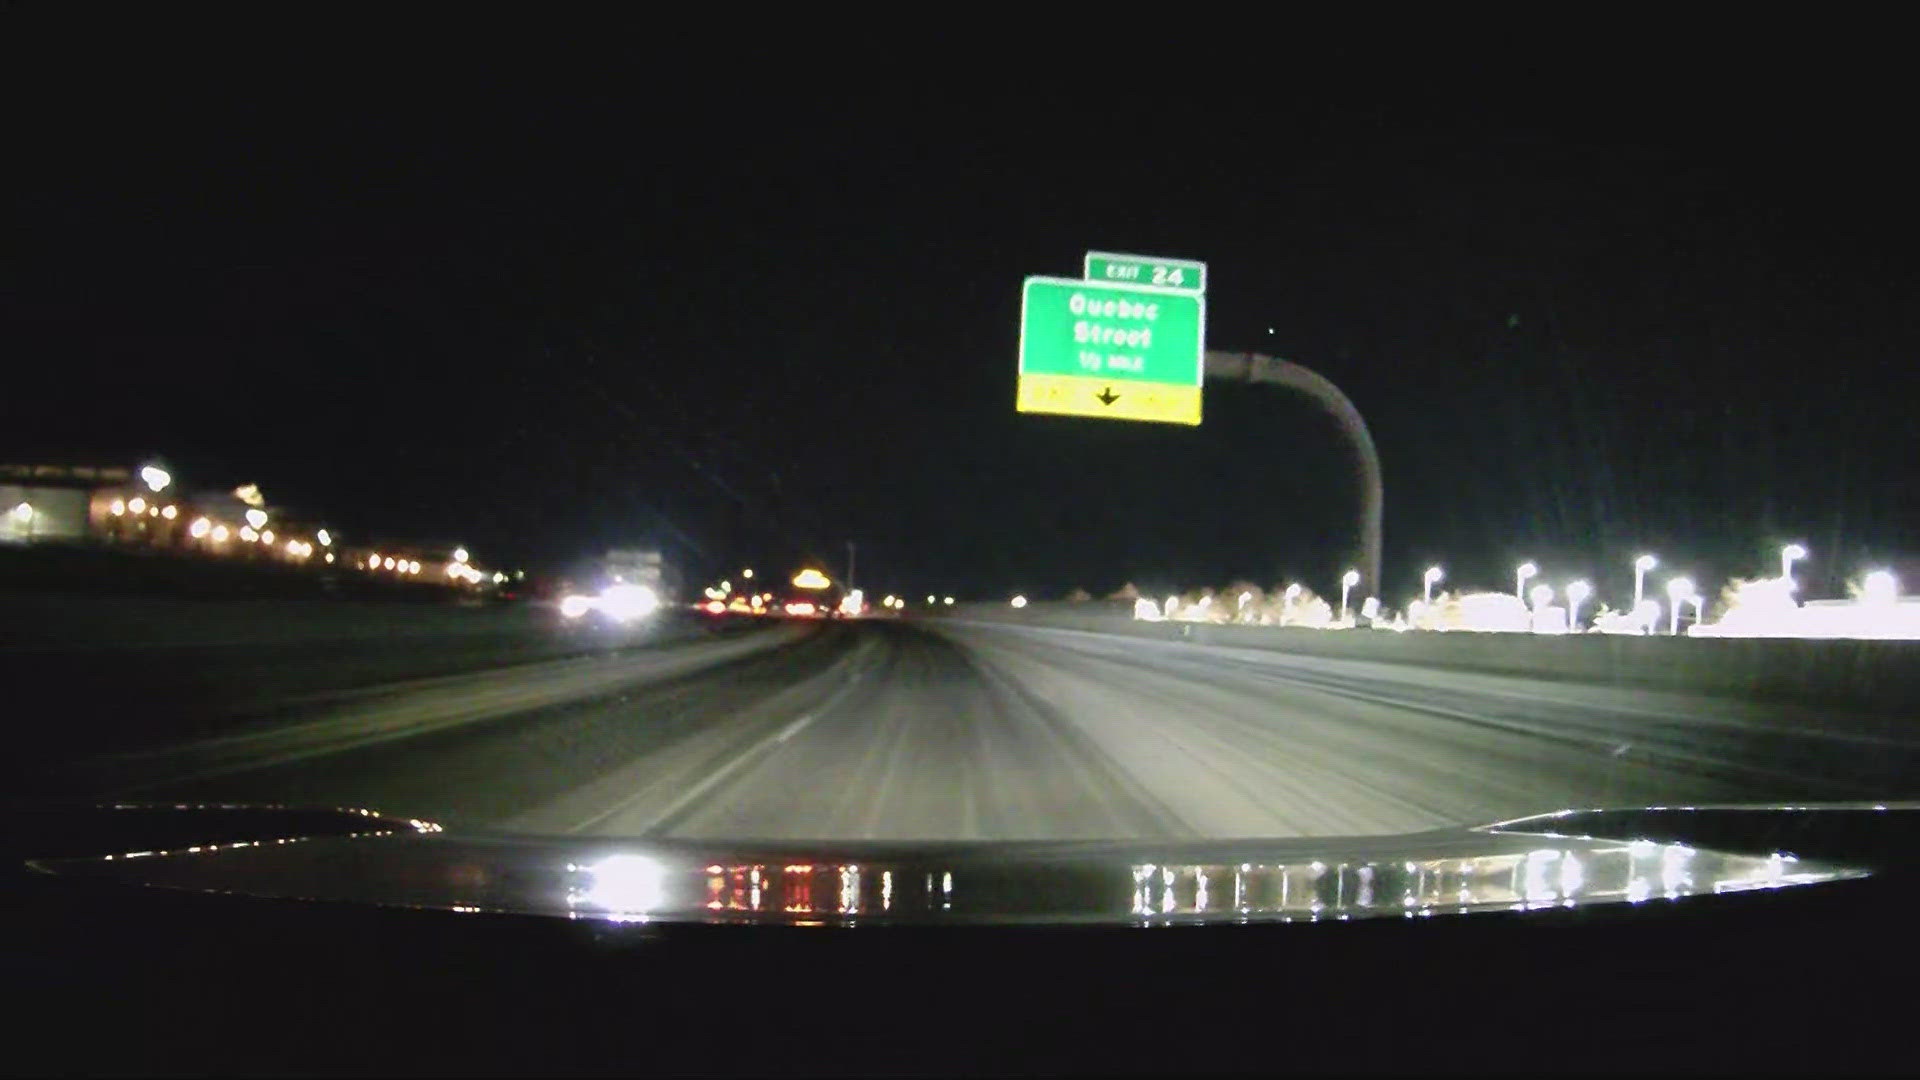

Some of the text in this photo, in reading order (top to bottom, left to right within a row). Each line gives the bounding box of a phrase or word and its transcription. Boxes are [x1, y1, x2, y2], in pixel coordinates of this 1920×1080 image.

[1151, 266, 1185, 285] 24
[1069, 293, 1159, 320] Quebec
[1073, 321, 1153, 349] Street
